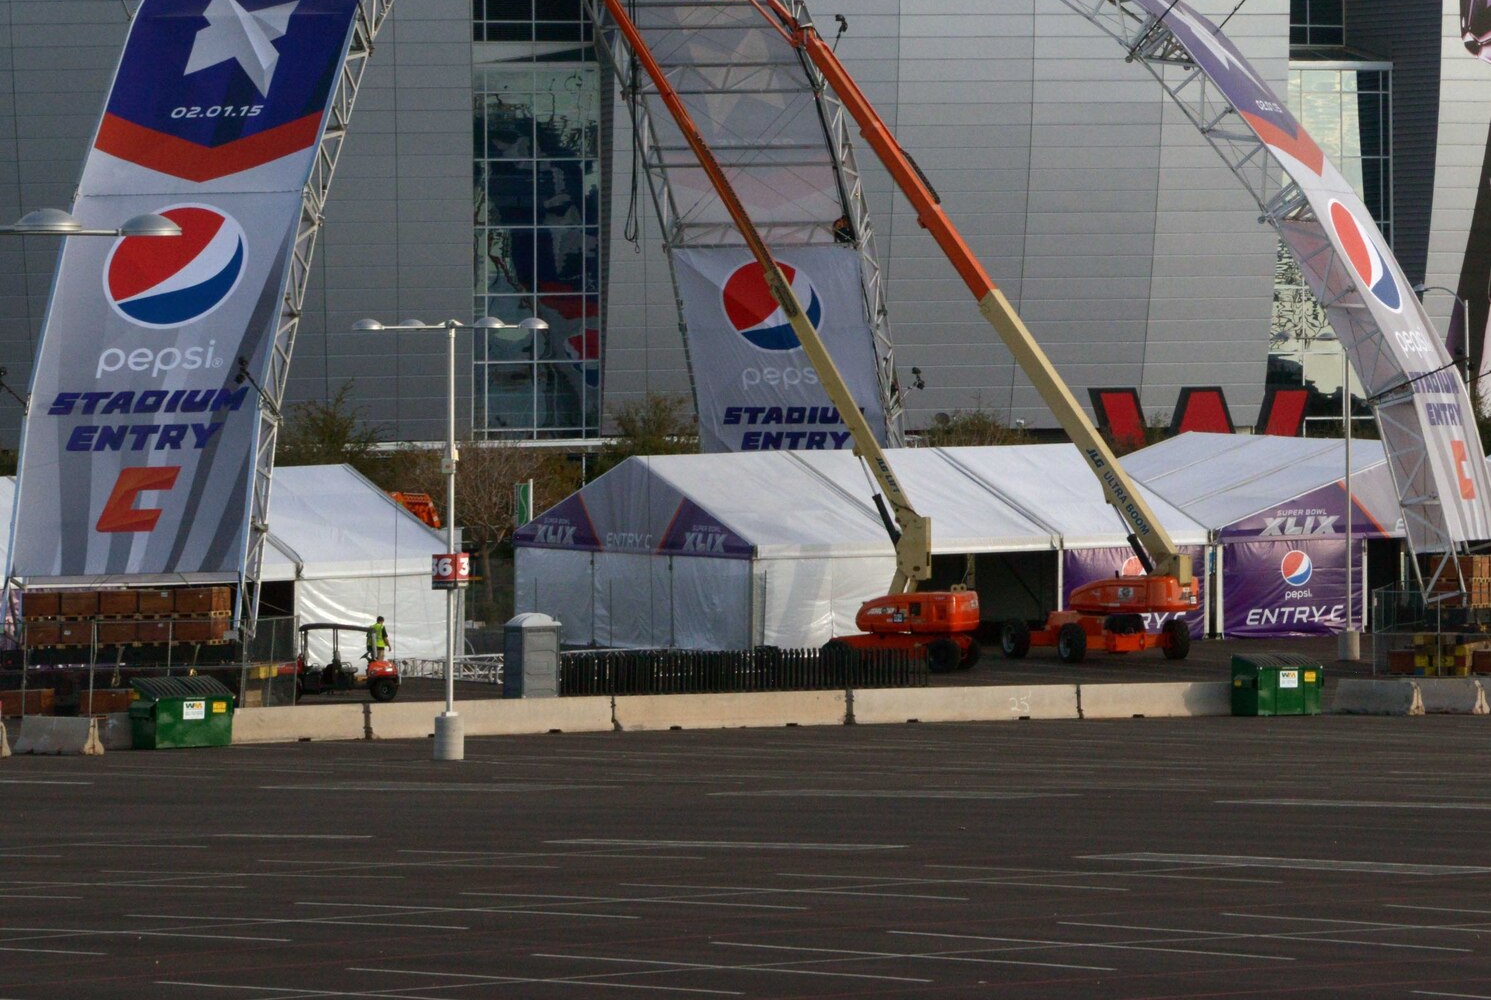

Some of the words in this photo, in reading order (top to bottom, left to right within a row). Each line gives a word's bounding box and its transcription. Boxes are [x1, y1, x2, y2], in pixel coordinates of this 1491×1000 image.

[170, 104, 264, 120] 02.01.15
[742, 367, 818, 390] peps
[47, 386, 250, 416] STADIUM
[723, 406, 865, 425] STADIU
[1425, 403, 1463, 426] ENTRY
[66, 422, 225, 452] ENTRY
[741, 431, 852, 450] ENTRY
[96, 466, 182, 533] C
[1086, 448, 1105, 469] JLG
[1103, 471, 1128, 504] ULTRA
[1126, 503, 1150, 536] BOOM
[1277, 509, 1304, 517] SUPER
[1305, 508, 1327, 516] BOWL
[533, 524, 577, 545] XLIX
[1258, 515, 1340, 537] XLIX
[606, 532, 642, 549] ENTRY
[683, 532, 728, 552] XLIX
[1285, 588, 1311, 600] pepsi
[1246, 605, 1326, 625] ENTRY
[1328, 604, 1345, 621] C
